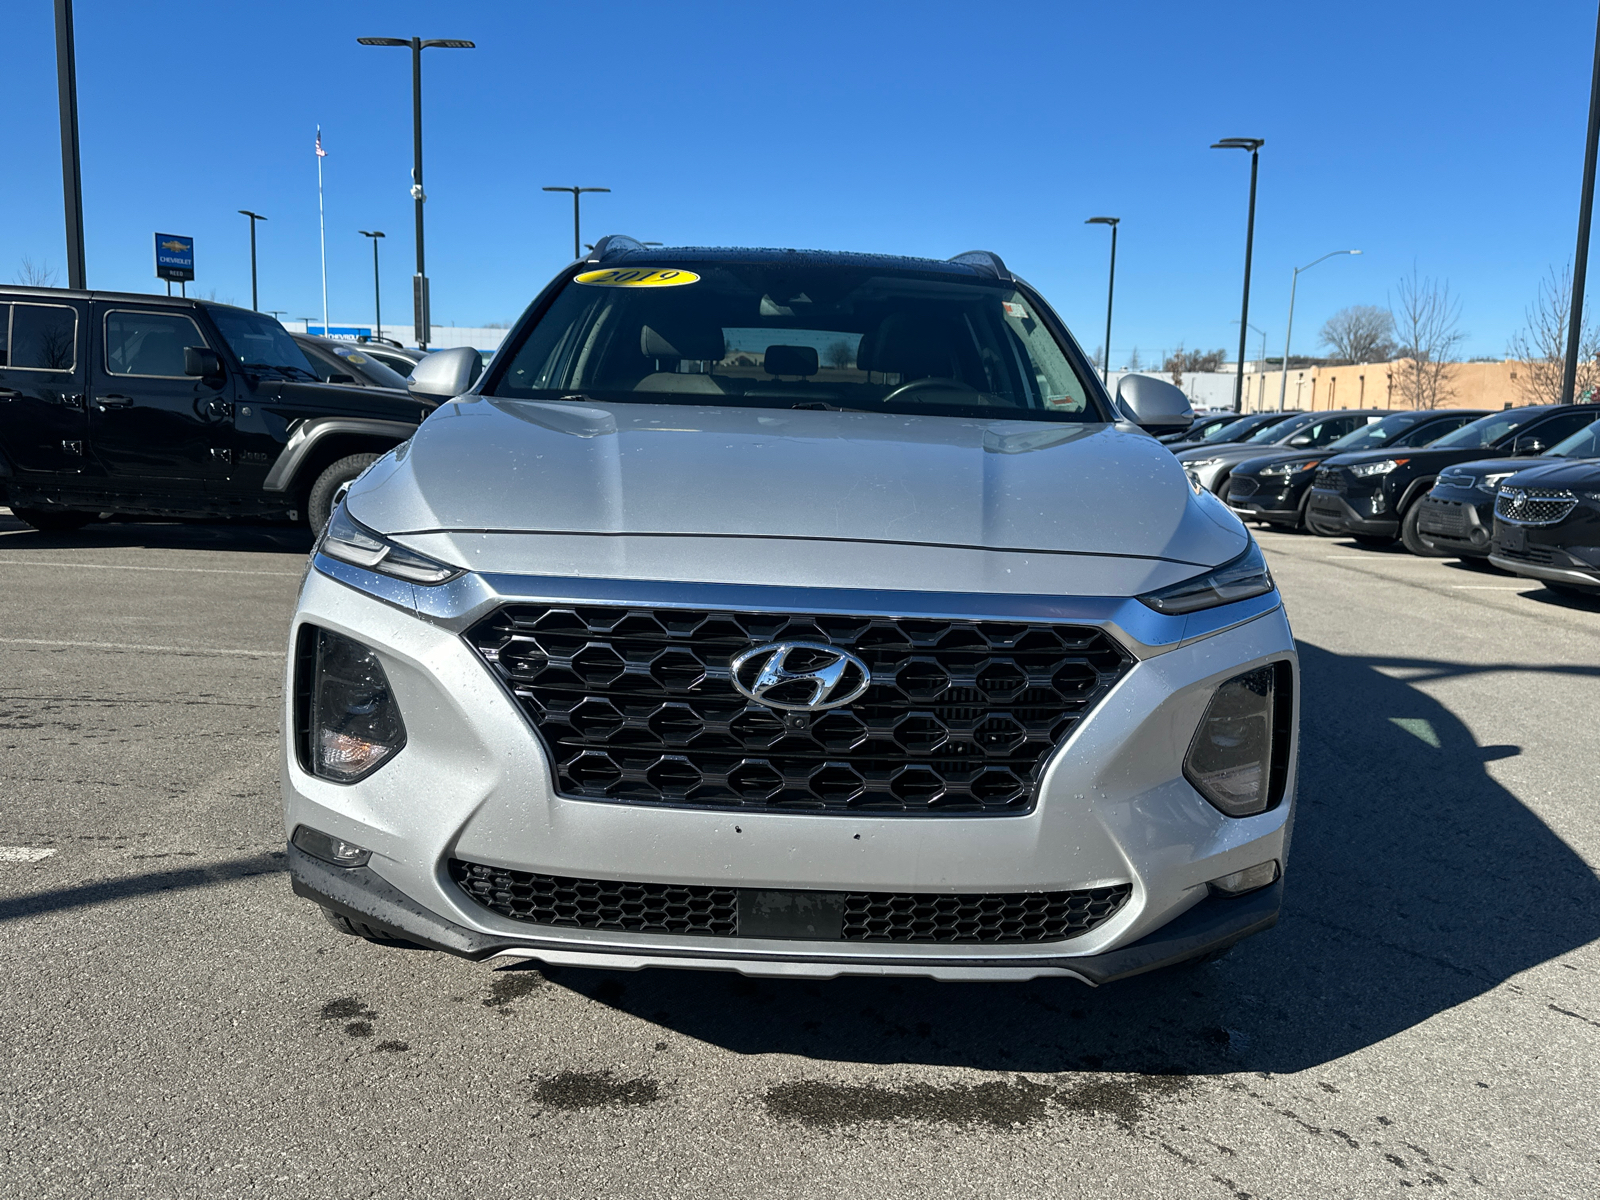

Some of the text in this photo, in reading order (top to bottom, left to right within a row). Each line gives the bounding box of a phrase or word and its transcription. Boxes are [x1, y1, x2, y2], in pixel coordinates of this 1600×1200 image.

[160, 256, 191, 265] CHEVROLET
[593, 271, 680, 282] 2019
[239, 449, 268, 461] Jeep
